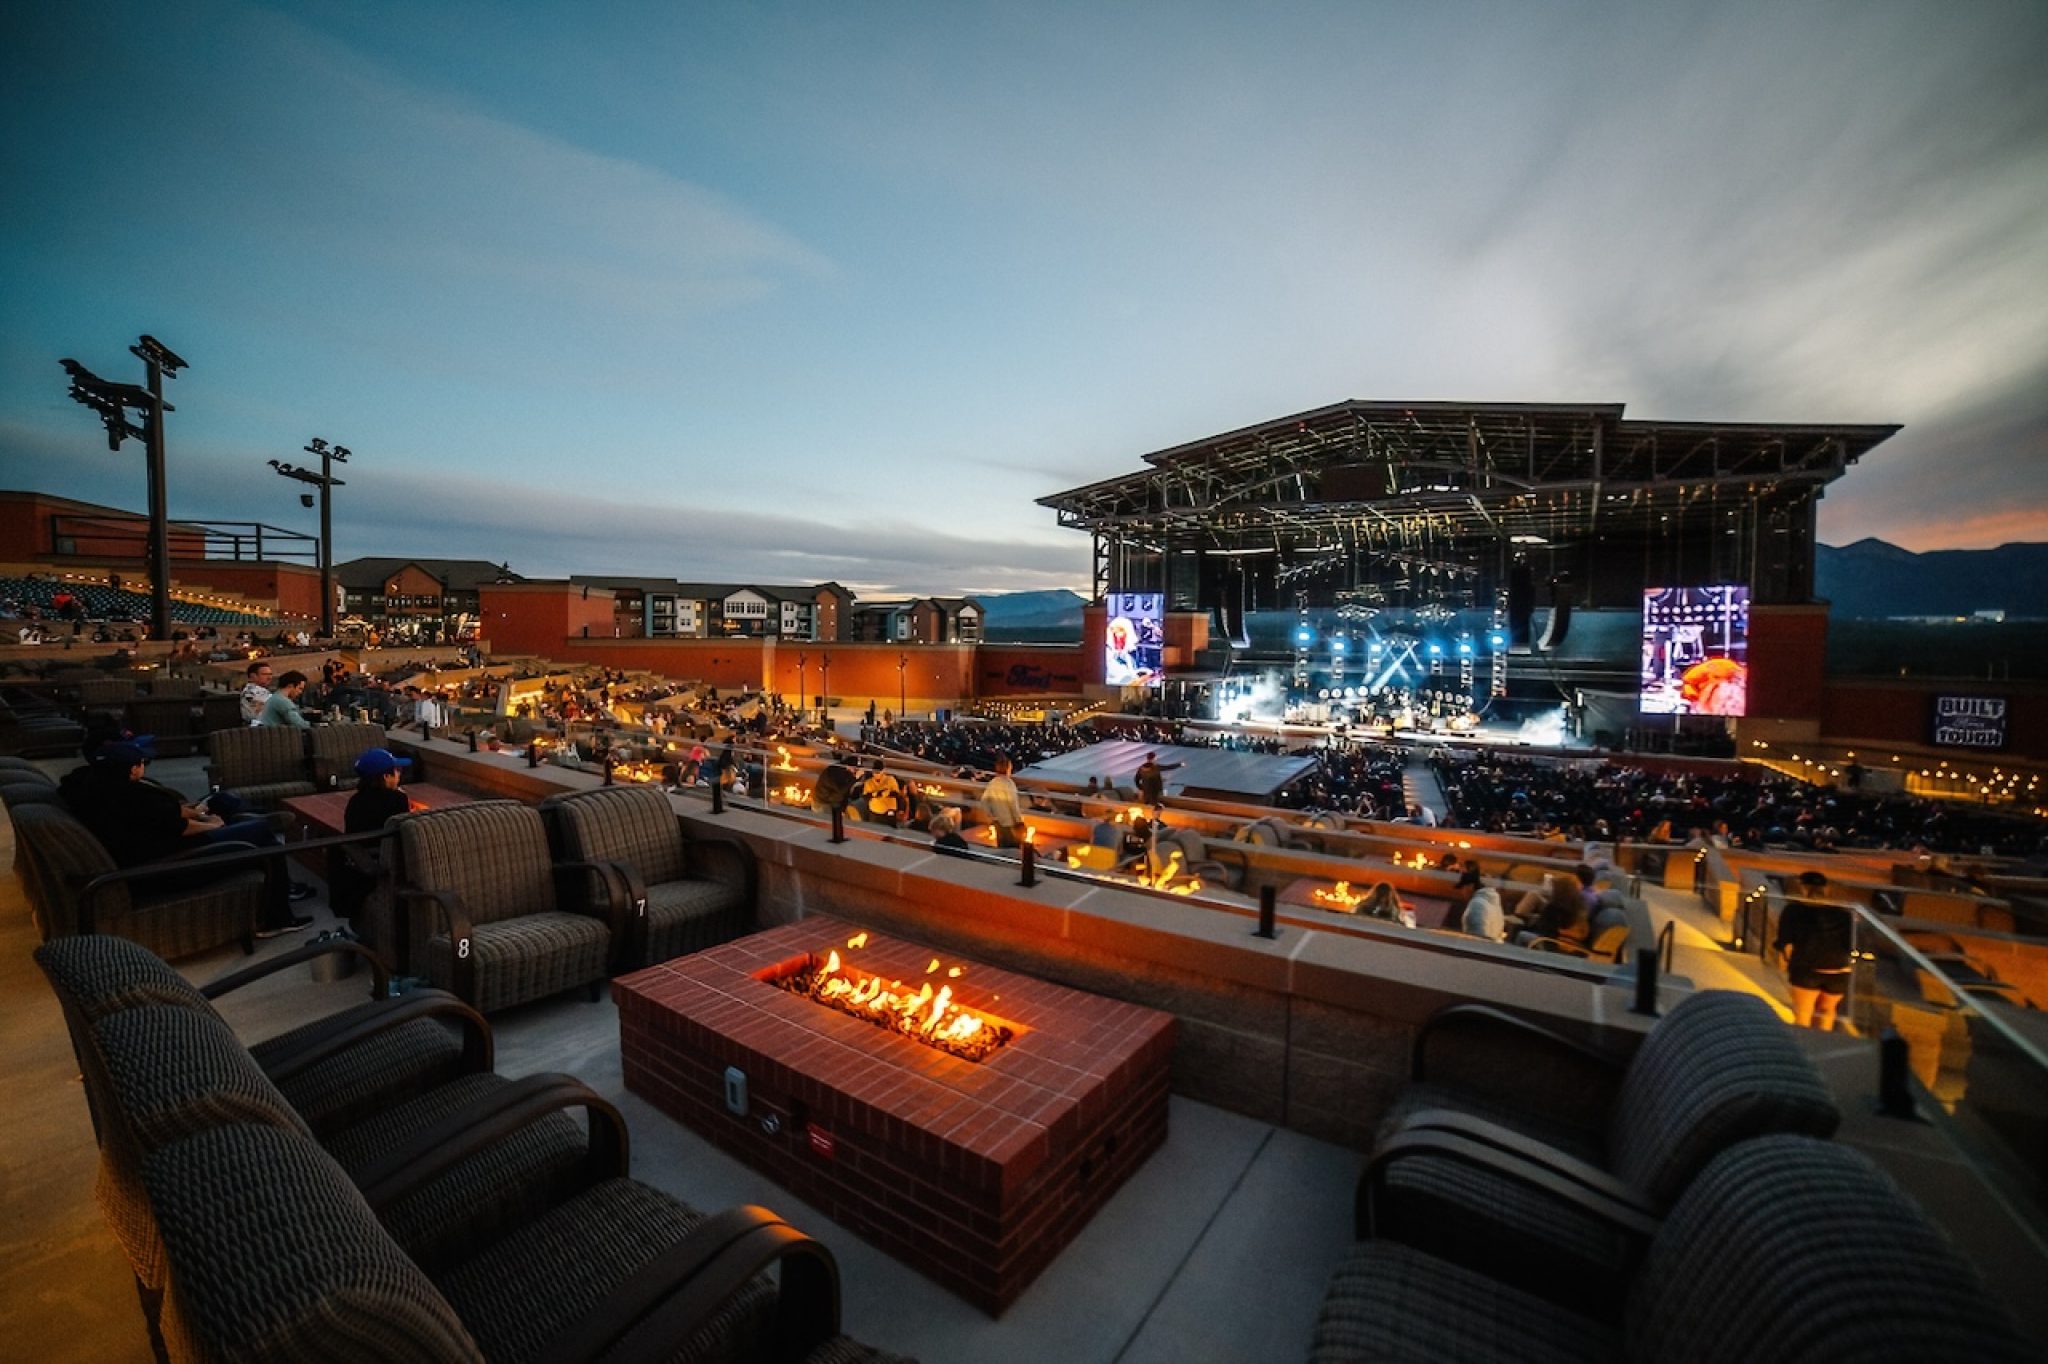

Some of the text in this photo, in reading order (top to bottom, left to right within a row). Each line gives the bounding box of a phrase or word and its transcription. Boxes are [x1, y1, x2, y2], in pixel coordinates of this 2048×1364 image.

[1938, 697, 2005, 718] BUILT
[636, 898, 646, 917] 7
[458, 938, 470, 959] 8
